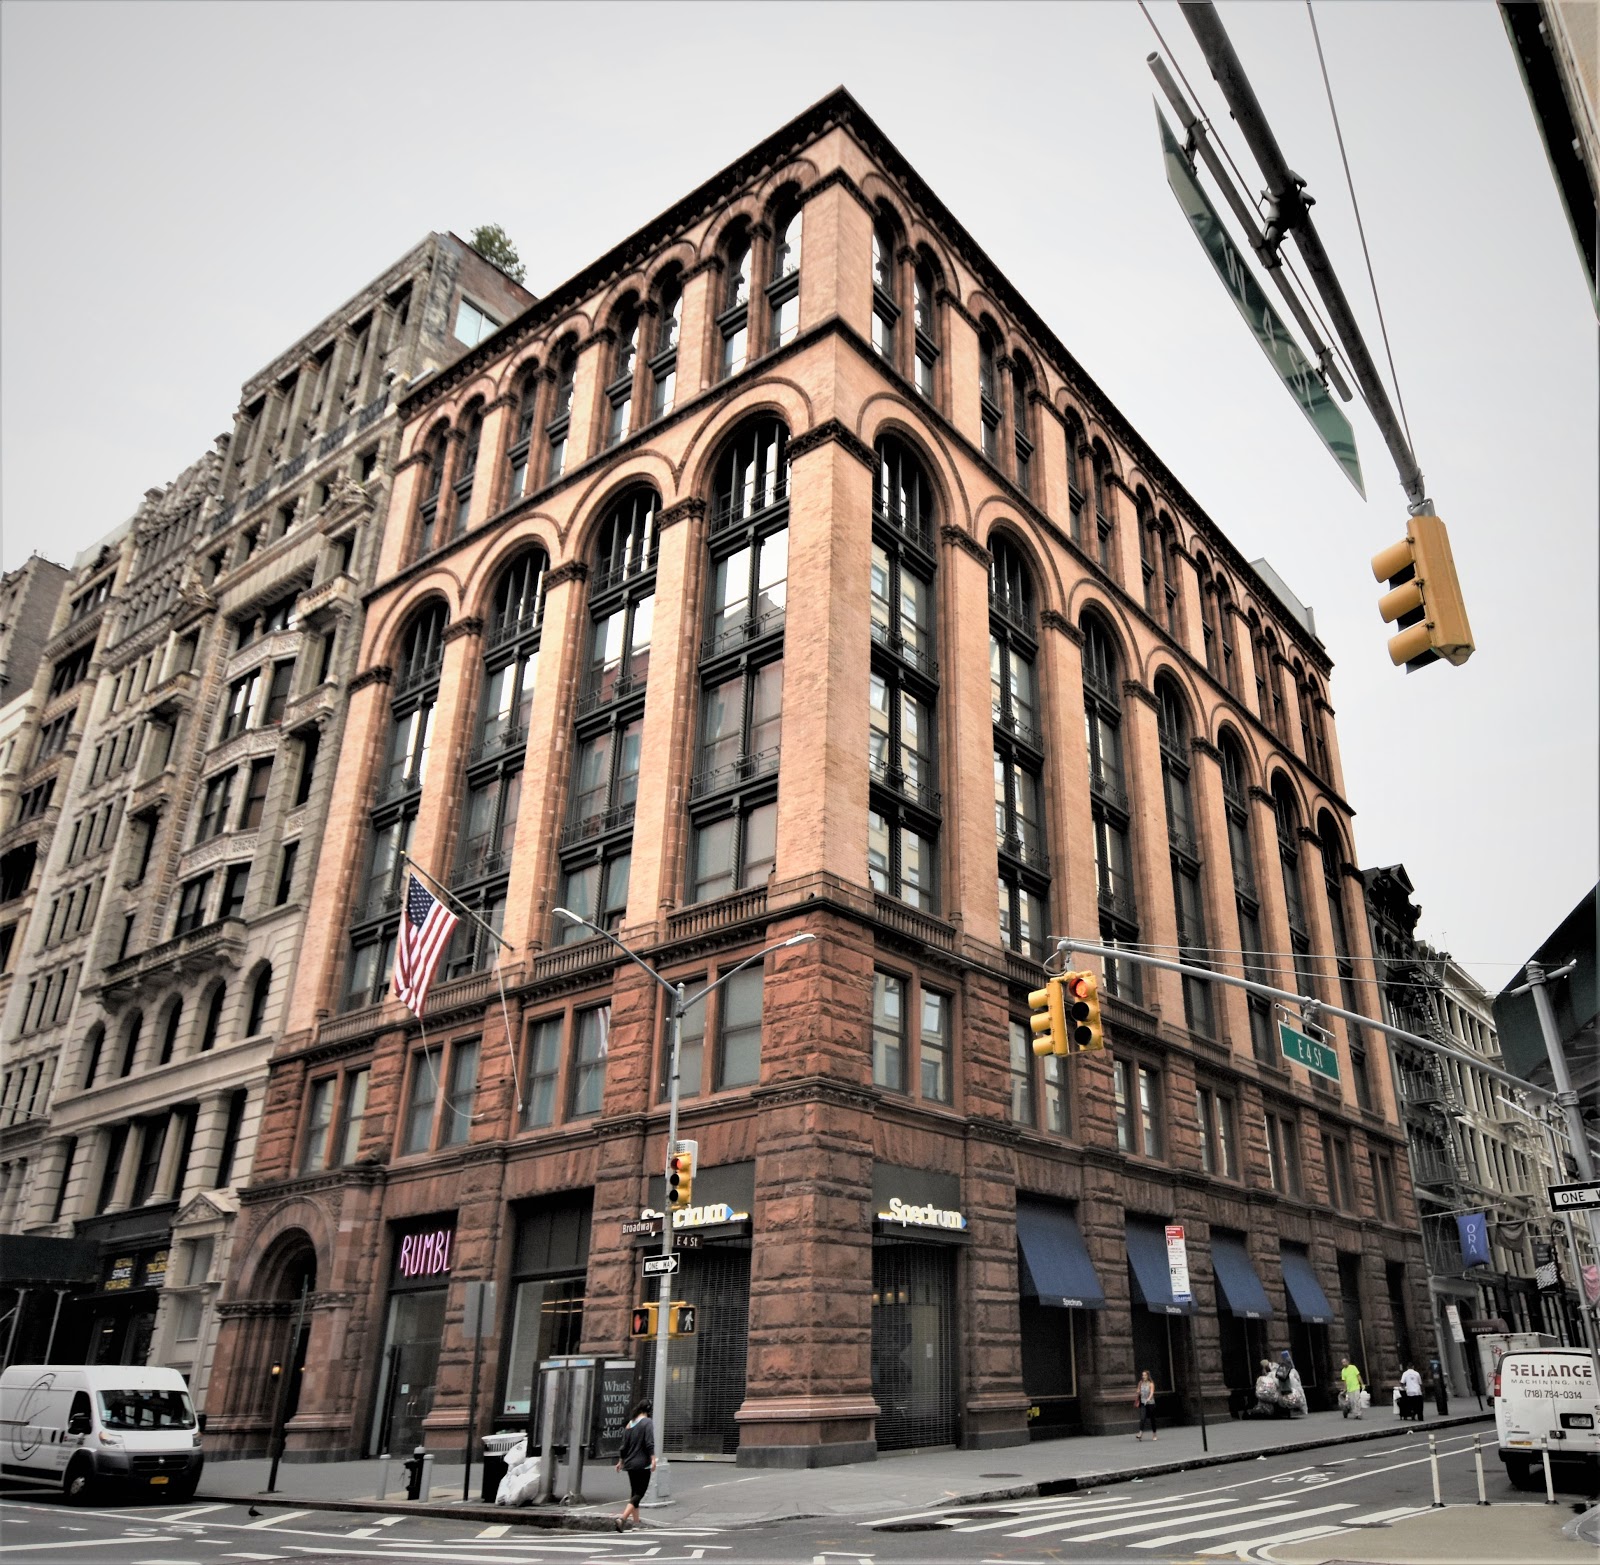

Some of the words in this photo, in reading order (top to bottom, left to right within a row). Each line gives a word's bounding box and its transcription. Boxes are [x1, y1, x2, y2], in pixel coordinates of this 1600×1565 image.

[1219, 231, 1247, 305] W
[1262, 306, 1278, 355] 4
[1287, 344, 1316, 414] St
[1297, 1038, 1305, 1059] E
[1306, 1043, 1312, 1063] 4
[1561, 1191, 1586, 1204] ONE
[889, 1197, 963, 1228] Spectrum
[622, 1221, 654, 1234] Broadway
[676, 1237, 681, 1246] E
[682, 1237, 688, 1246] 4
[689, 1237, 698, 1247] St
[1466, 1223, 1478, 1255] ORA
[647, 1262, 659, 1271] ONE
[662, 1260, 674, 1268] WAY
[603, 1394, 630, 1405] wrong
[1524, 1389, 1543, 1399] (718)
[606, 1404, 624, 1414] with
[604, 1417, 624, 1428] your
[602, 1428, 624, 1438] skin?
